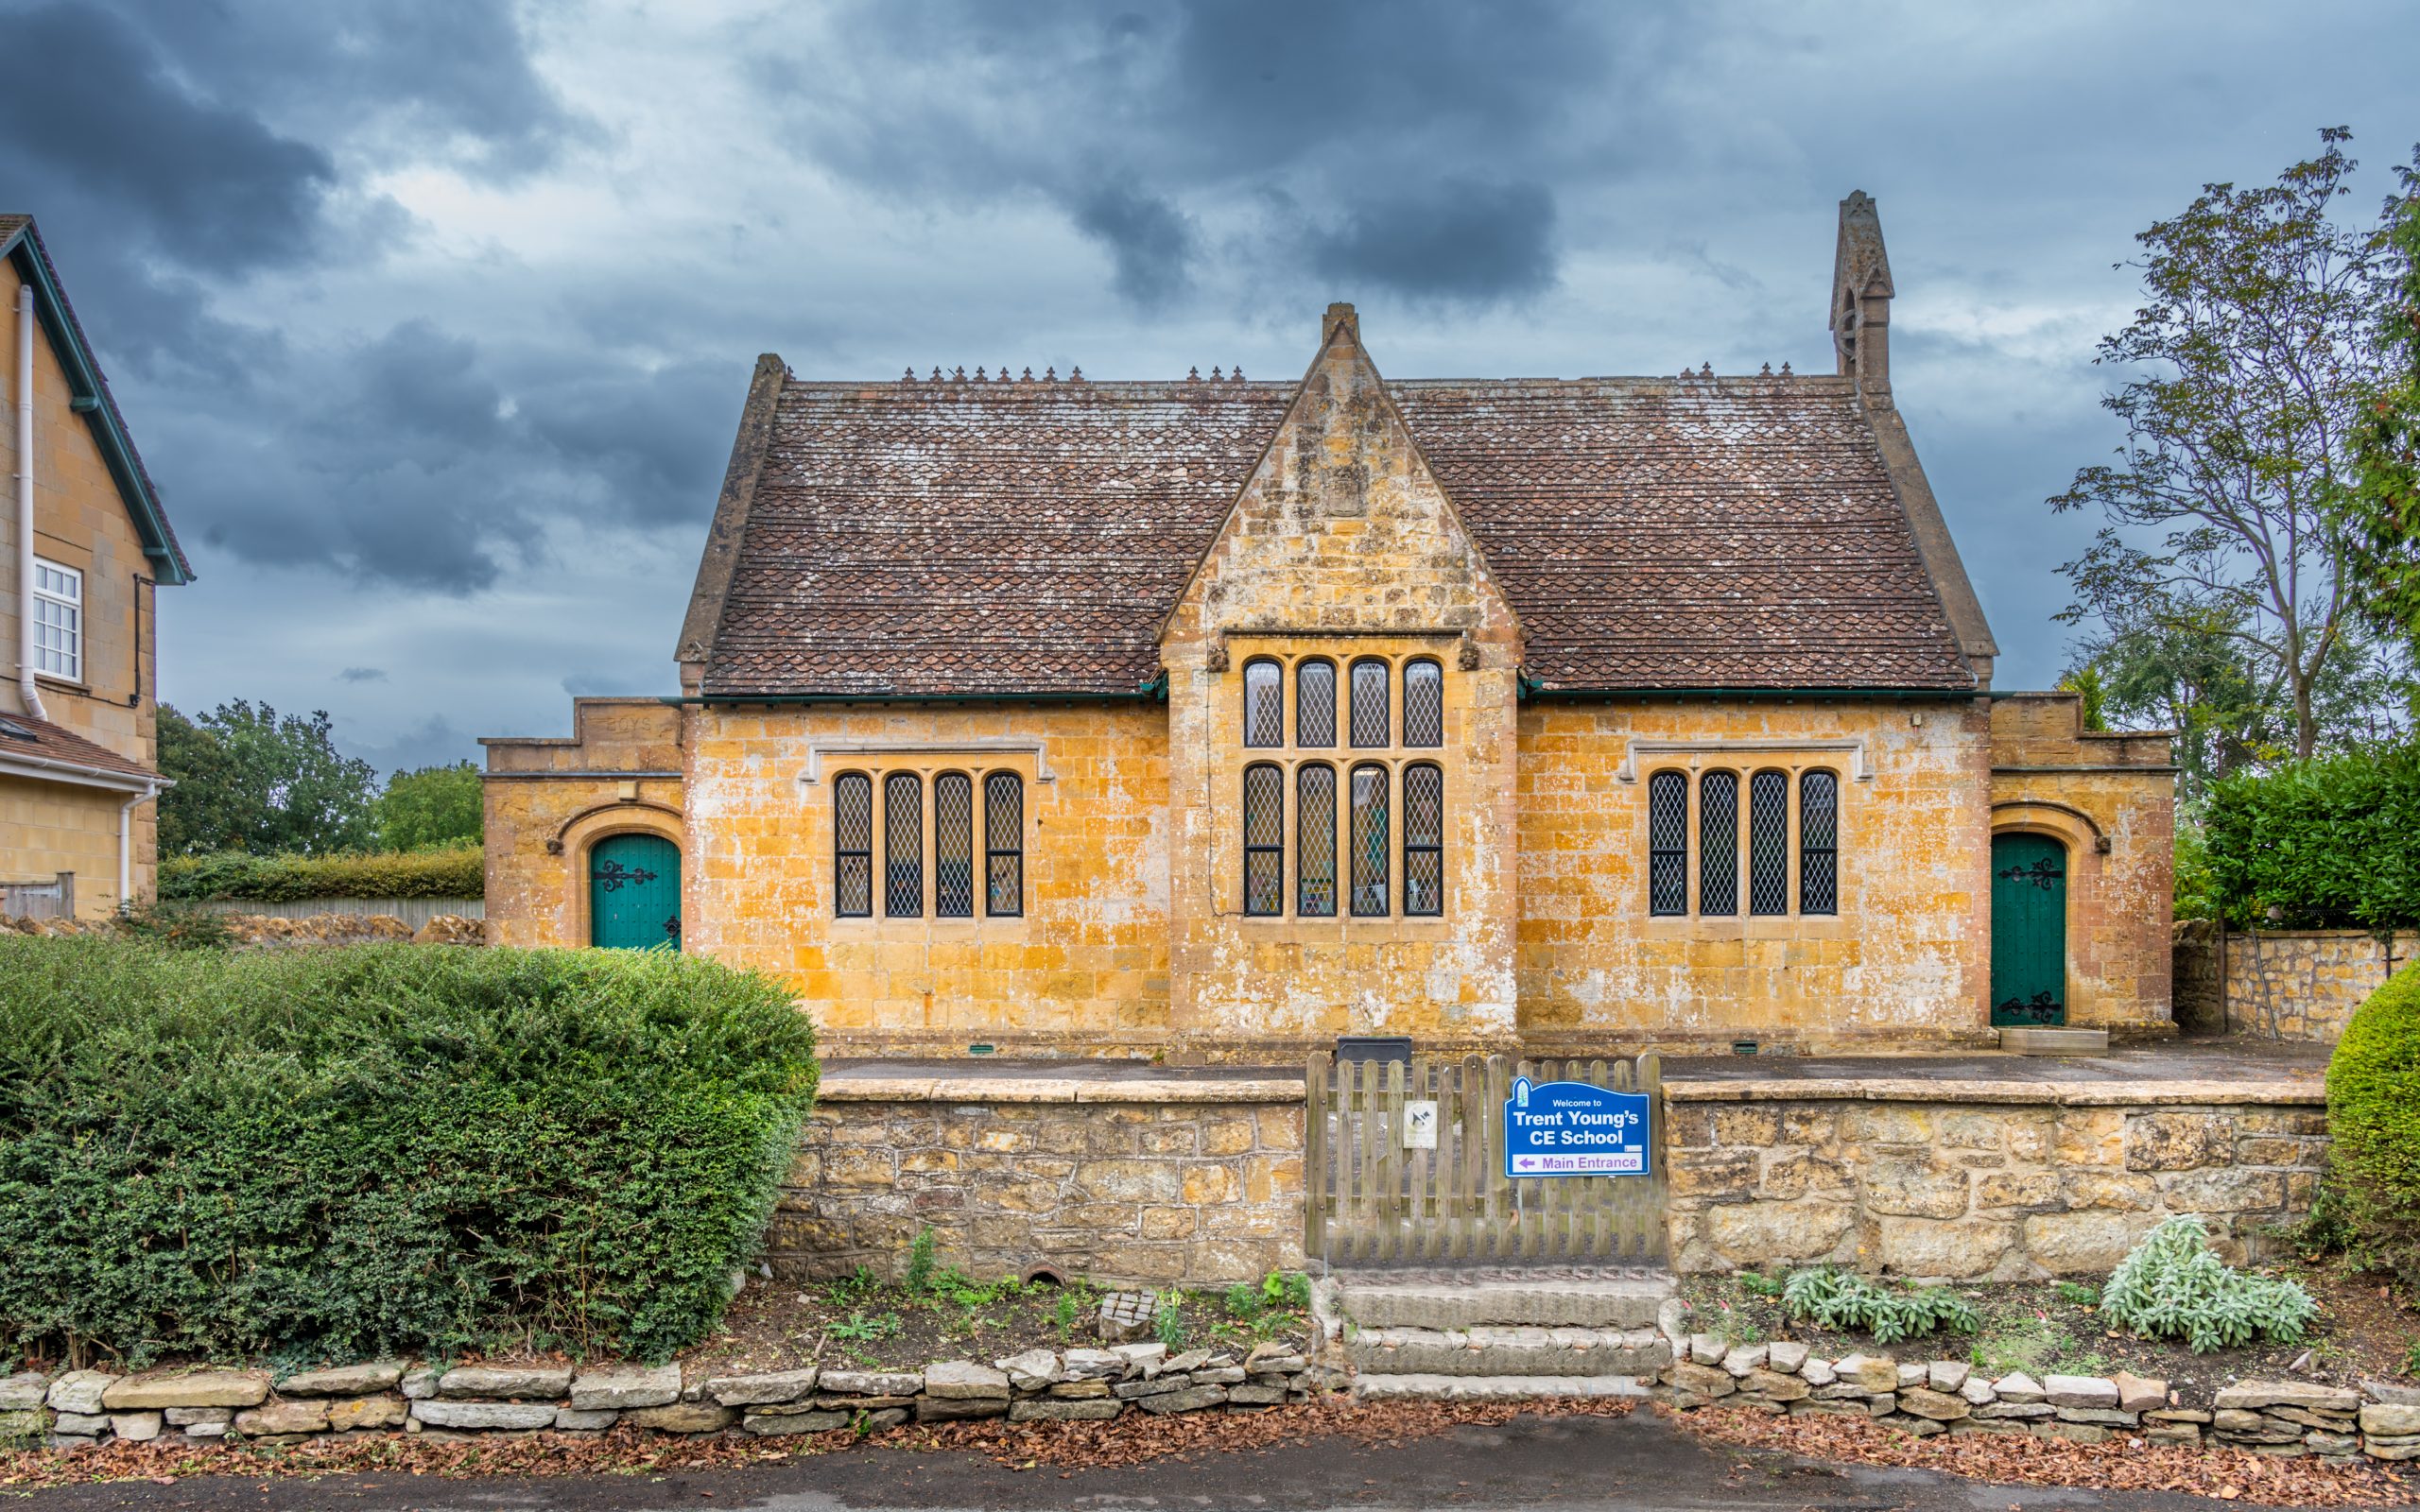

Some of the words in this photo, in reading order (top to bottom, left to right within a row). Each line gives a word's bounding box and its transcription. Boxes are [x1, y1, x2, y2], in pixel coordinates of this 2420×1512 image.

[1552, 1099, 1592, 1108] Welcome
[1593, 1099, 1602, 1108] to
[1512, 1111, 1563, 1126] Trent
[1567, 1109, 1639, 1128] Young's
[1530, 1130, 1556, 1145] CE
[1561, 1129, 1623, 1145] School
[1542, 1157, 1574, 1170] Main
[1578, 1156, 1637, 1169] Entrance
